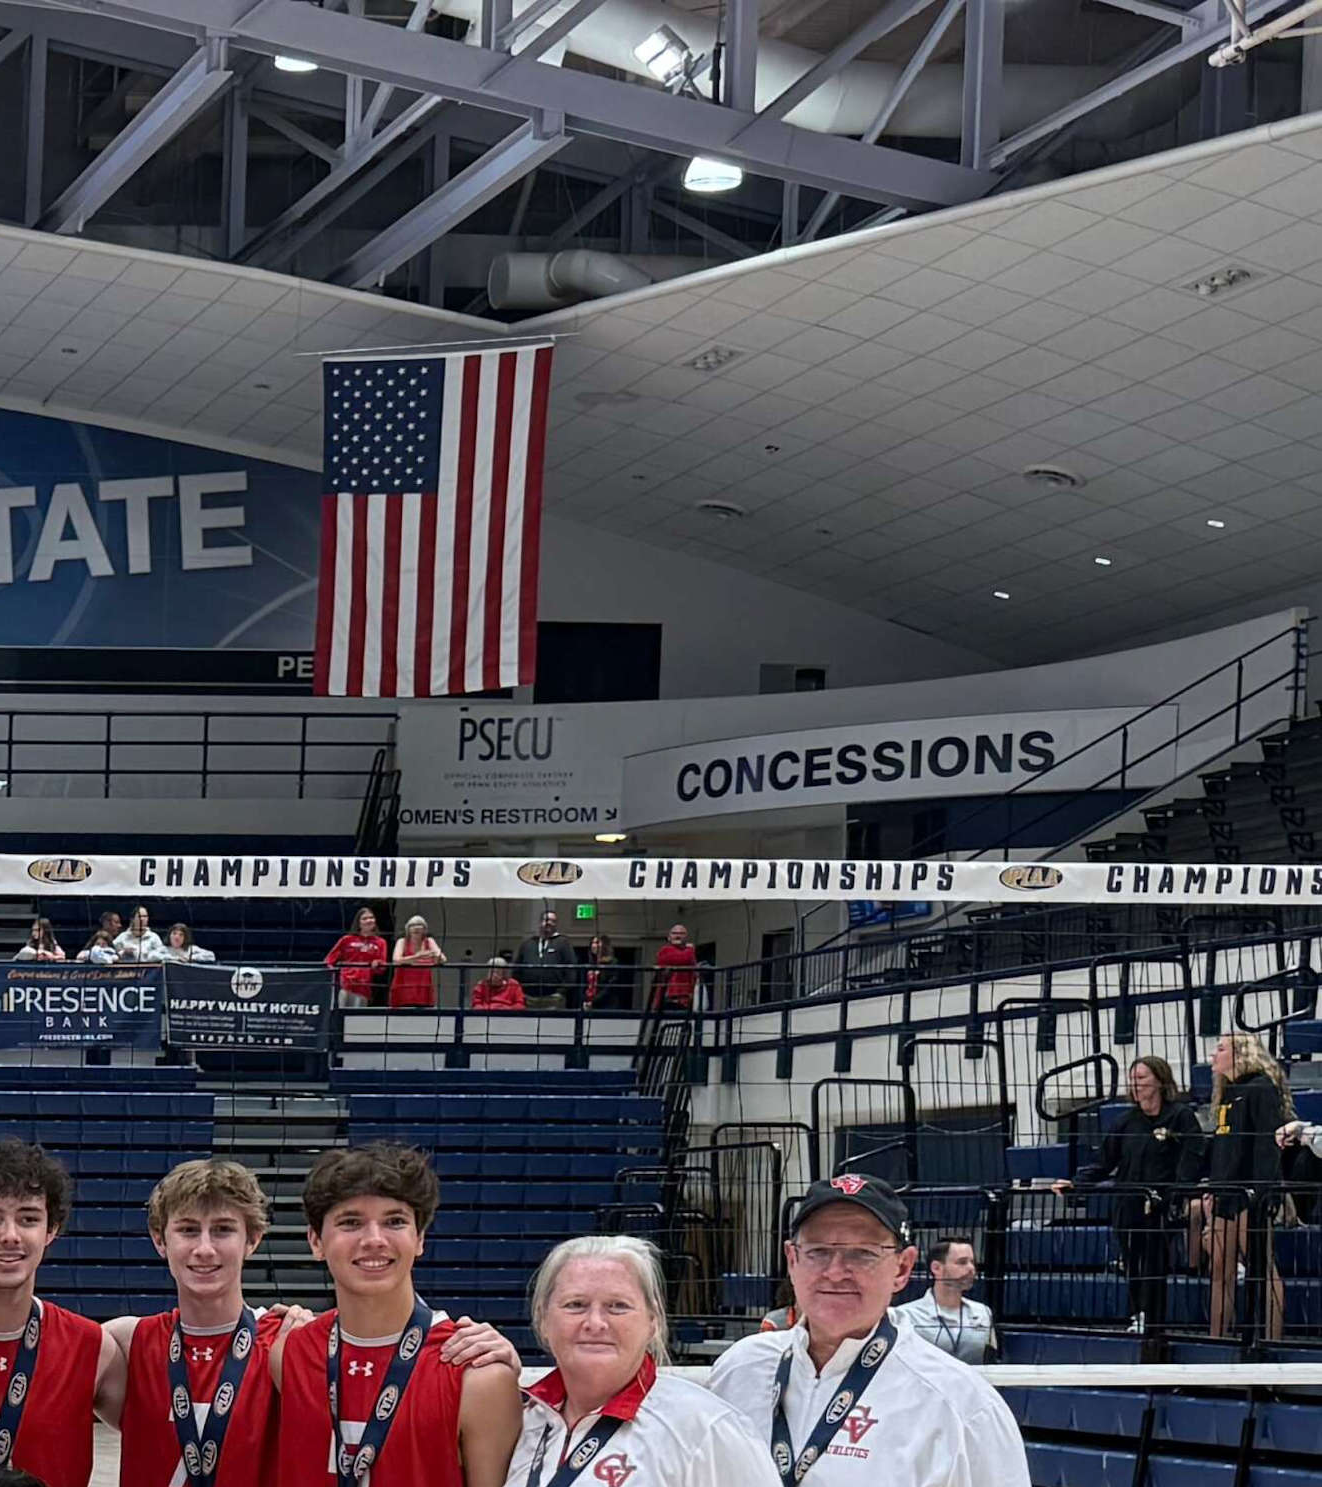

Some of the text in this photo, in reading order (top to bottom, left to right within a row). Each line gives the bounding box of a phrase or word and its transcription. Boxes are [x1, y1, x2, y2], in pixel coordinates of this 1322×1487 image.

[458, 716, 554, 762] PSECU
[675, 728, 1057, 803] CONCESSIONS
[480, 806, 598, 825] RESTROOM
[140, 859, 471, 888] CHAMPIONSHIPS
[525, 862, 579, 884] PIAA
[629, 861, 954, 891] CHAMPIONSHIPS
[8, 986, 156, 1013] PRESENCE
[170, 999, 320, 1015] HAPPY VALLEY HOTELS
[45, 1016, 108, 1028] BANK
